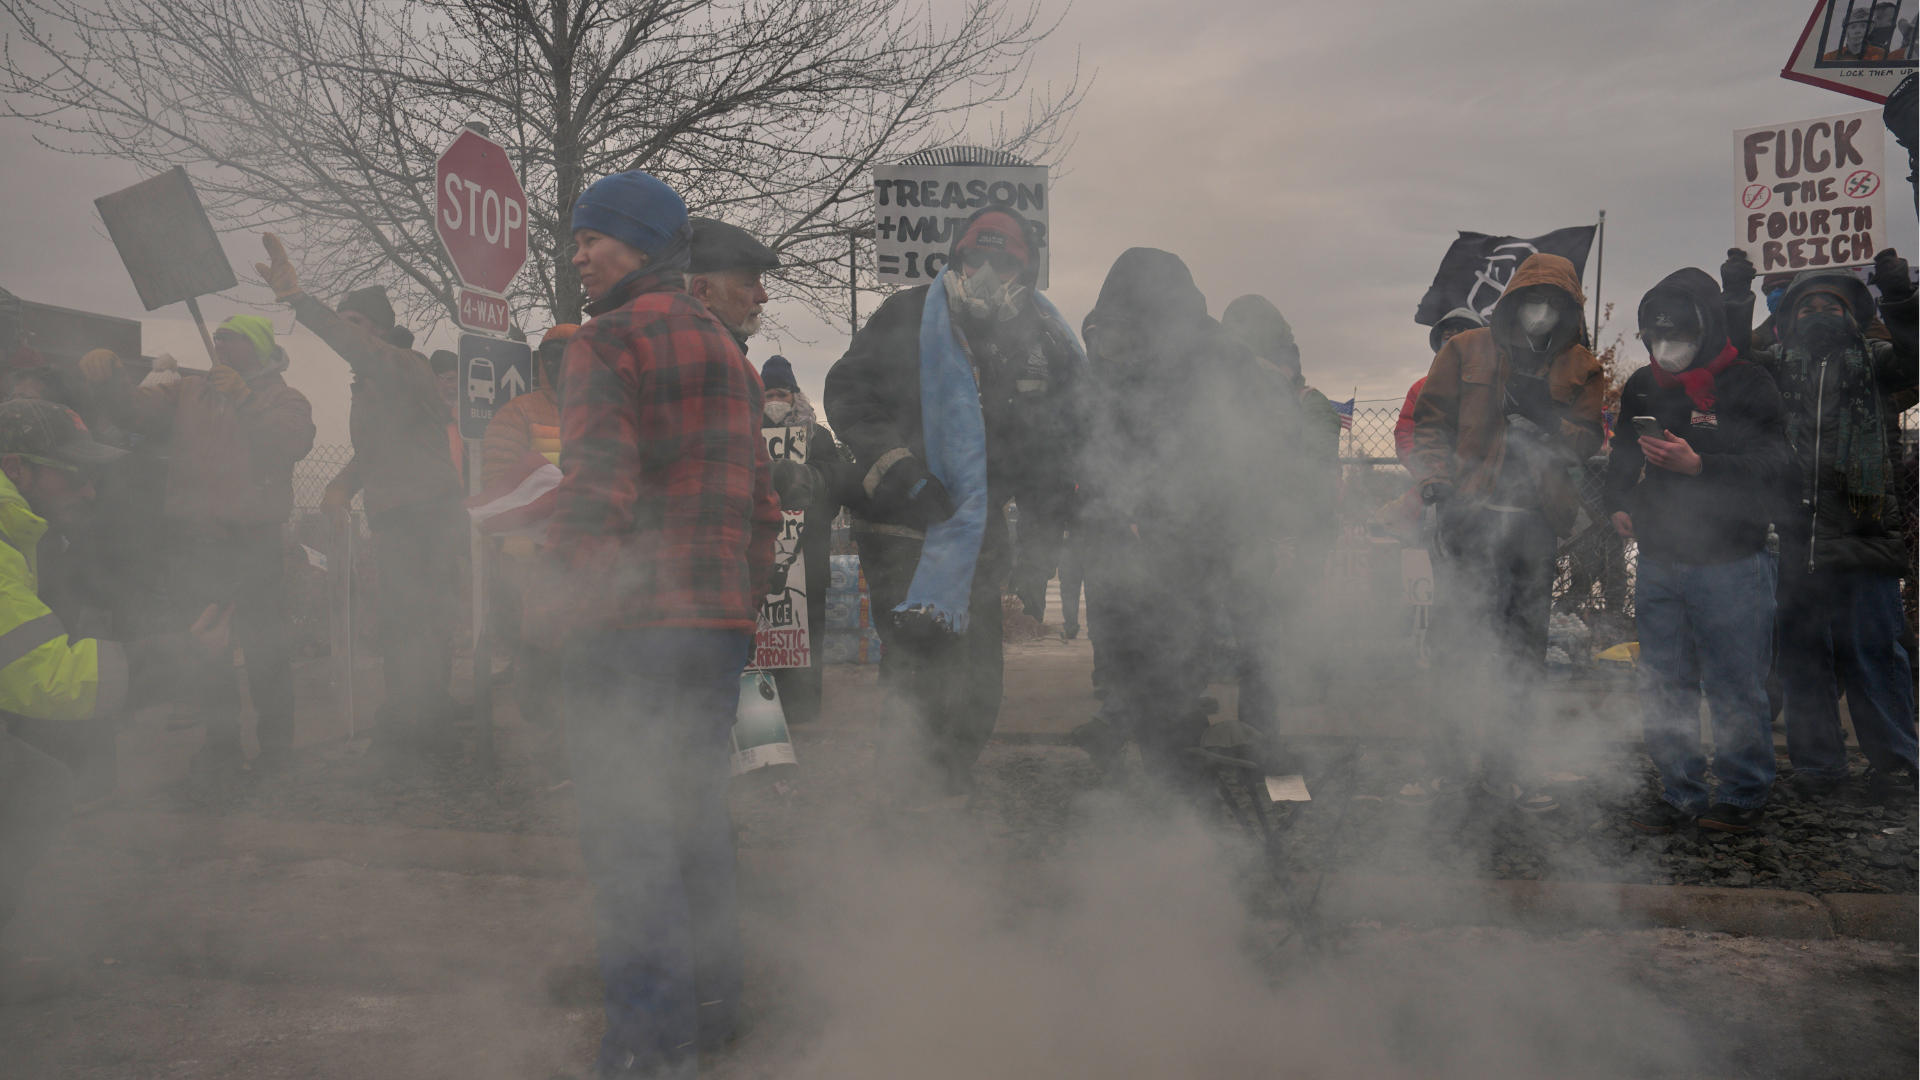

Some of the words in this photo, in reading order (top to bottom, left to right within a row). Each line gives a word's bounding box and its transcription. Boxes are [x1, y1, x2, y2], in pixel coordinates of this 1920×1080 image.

[1839, 69, 1864, 77] LOCK
[1869, 69, 1894, 77] THEM
[1743, 118, 1864, 183] FUCK
[874, 178, 1044, 211] TREASON
[1772, 177, 1839, 206] THE
[443, 172, 522, 249] STOP
[1747, 205, 1873, 243] FOURTH
[879, 251, 948, 279] =IC
[1762, 231, 1874, 271] REICH
[463, 297, 505, 326] 4-WAY
[470, 408, 493, 419] BLUE
[763, 427, 804, 459] ck
[768, 603, 791, 624] ICE
[755, 628, 806, 649] MESTIC
[749, 647, 810, 667] RRORIST
